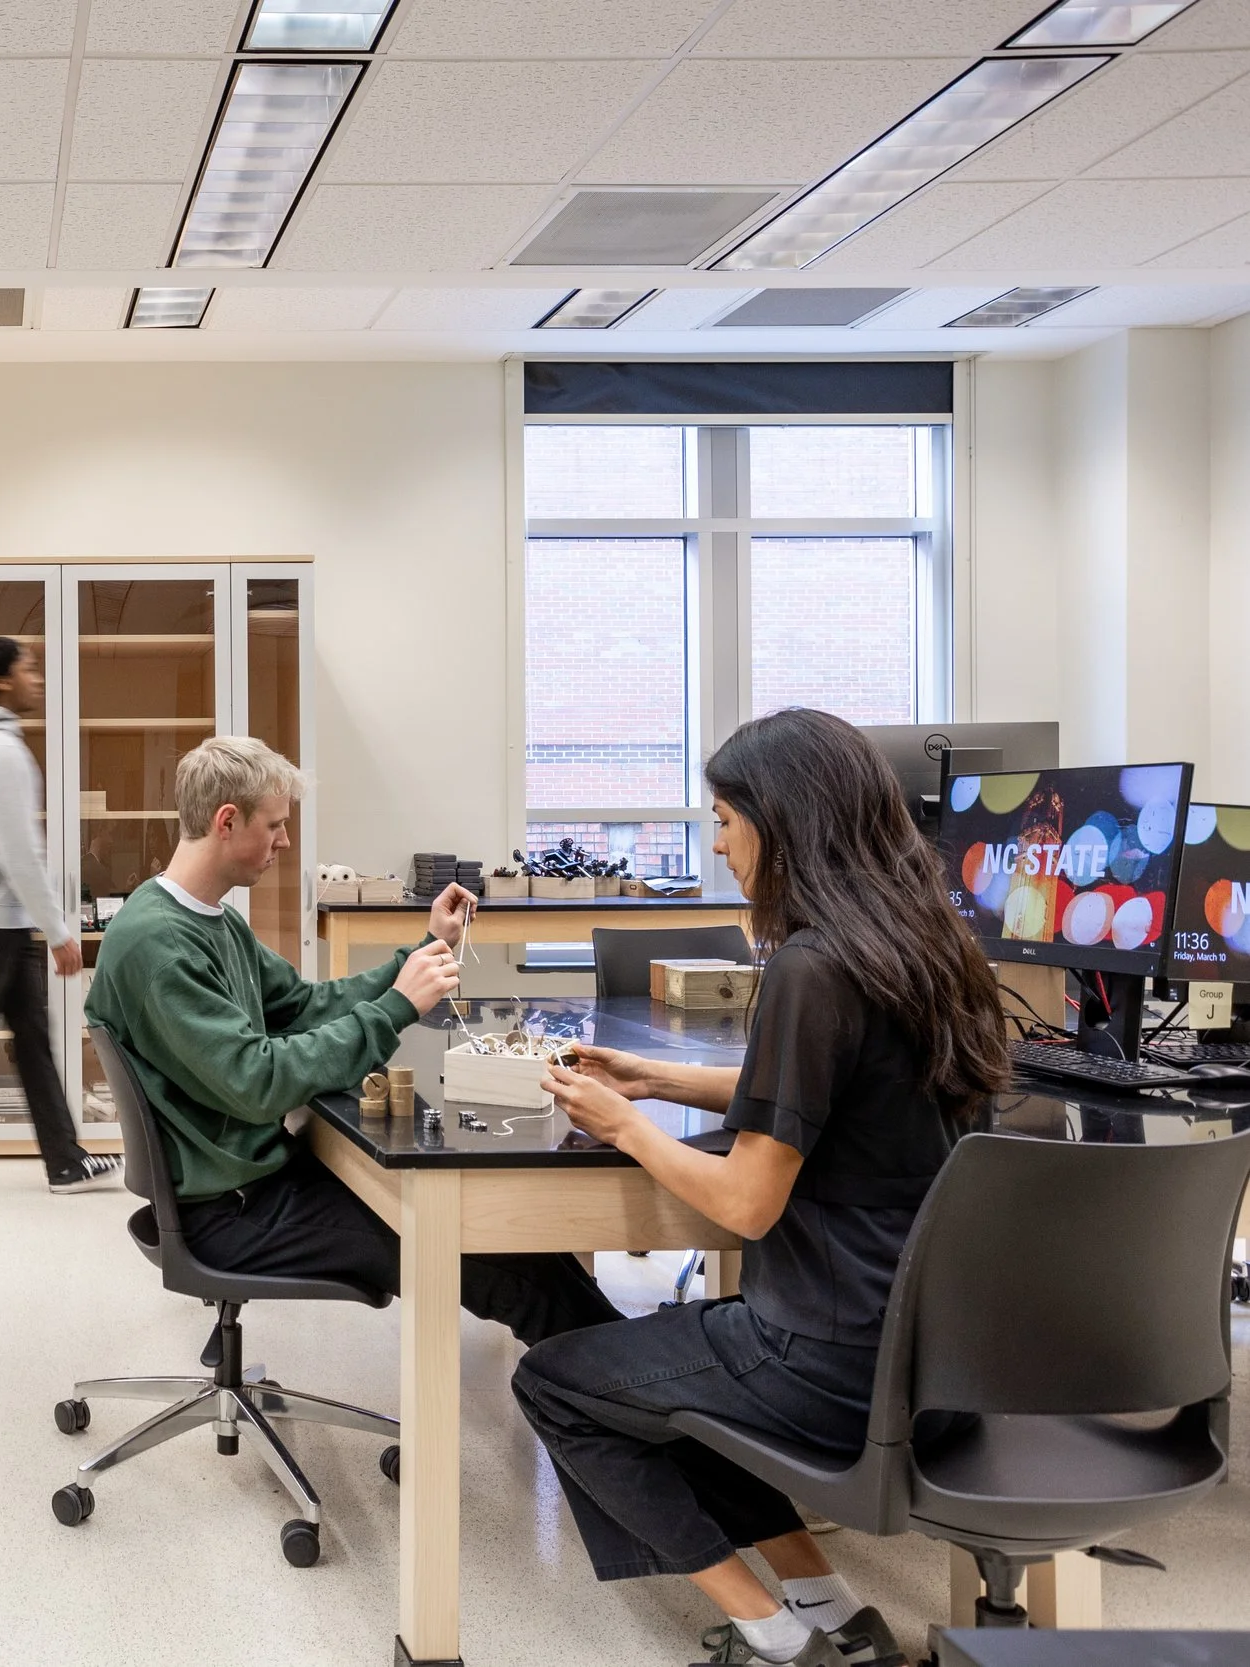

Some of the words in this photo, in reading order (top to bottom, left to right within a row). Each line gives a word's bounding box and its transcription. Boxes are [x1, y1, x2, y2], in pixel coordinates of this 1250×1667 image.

[982, 843, 1018, 874] NC
[1025, 844, 1108, 878] STATE
[1174, 932, 1209, 949] 11:36
[1022, 947, 1036, 955] DELL
[1173, 951, 1195, 962] Friday,
[1196, 952, 1218, 961] March
[1219, 953, 1227, 961] 10
[1200, 989, 1224, 1000] Group
[1206, 1004, 1214, 1019] J
